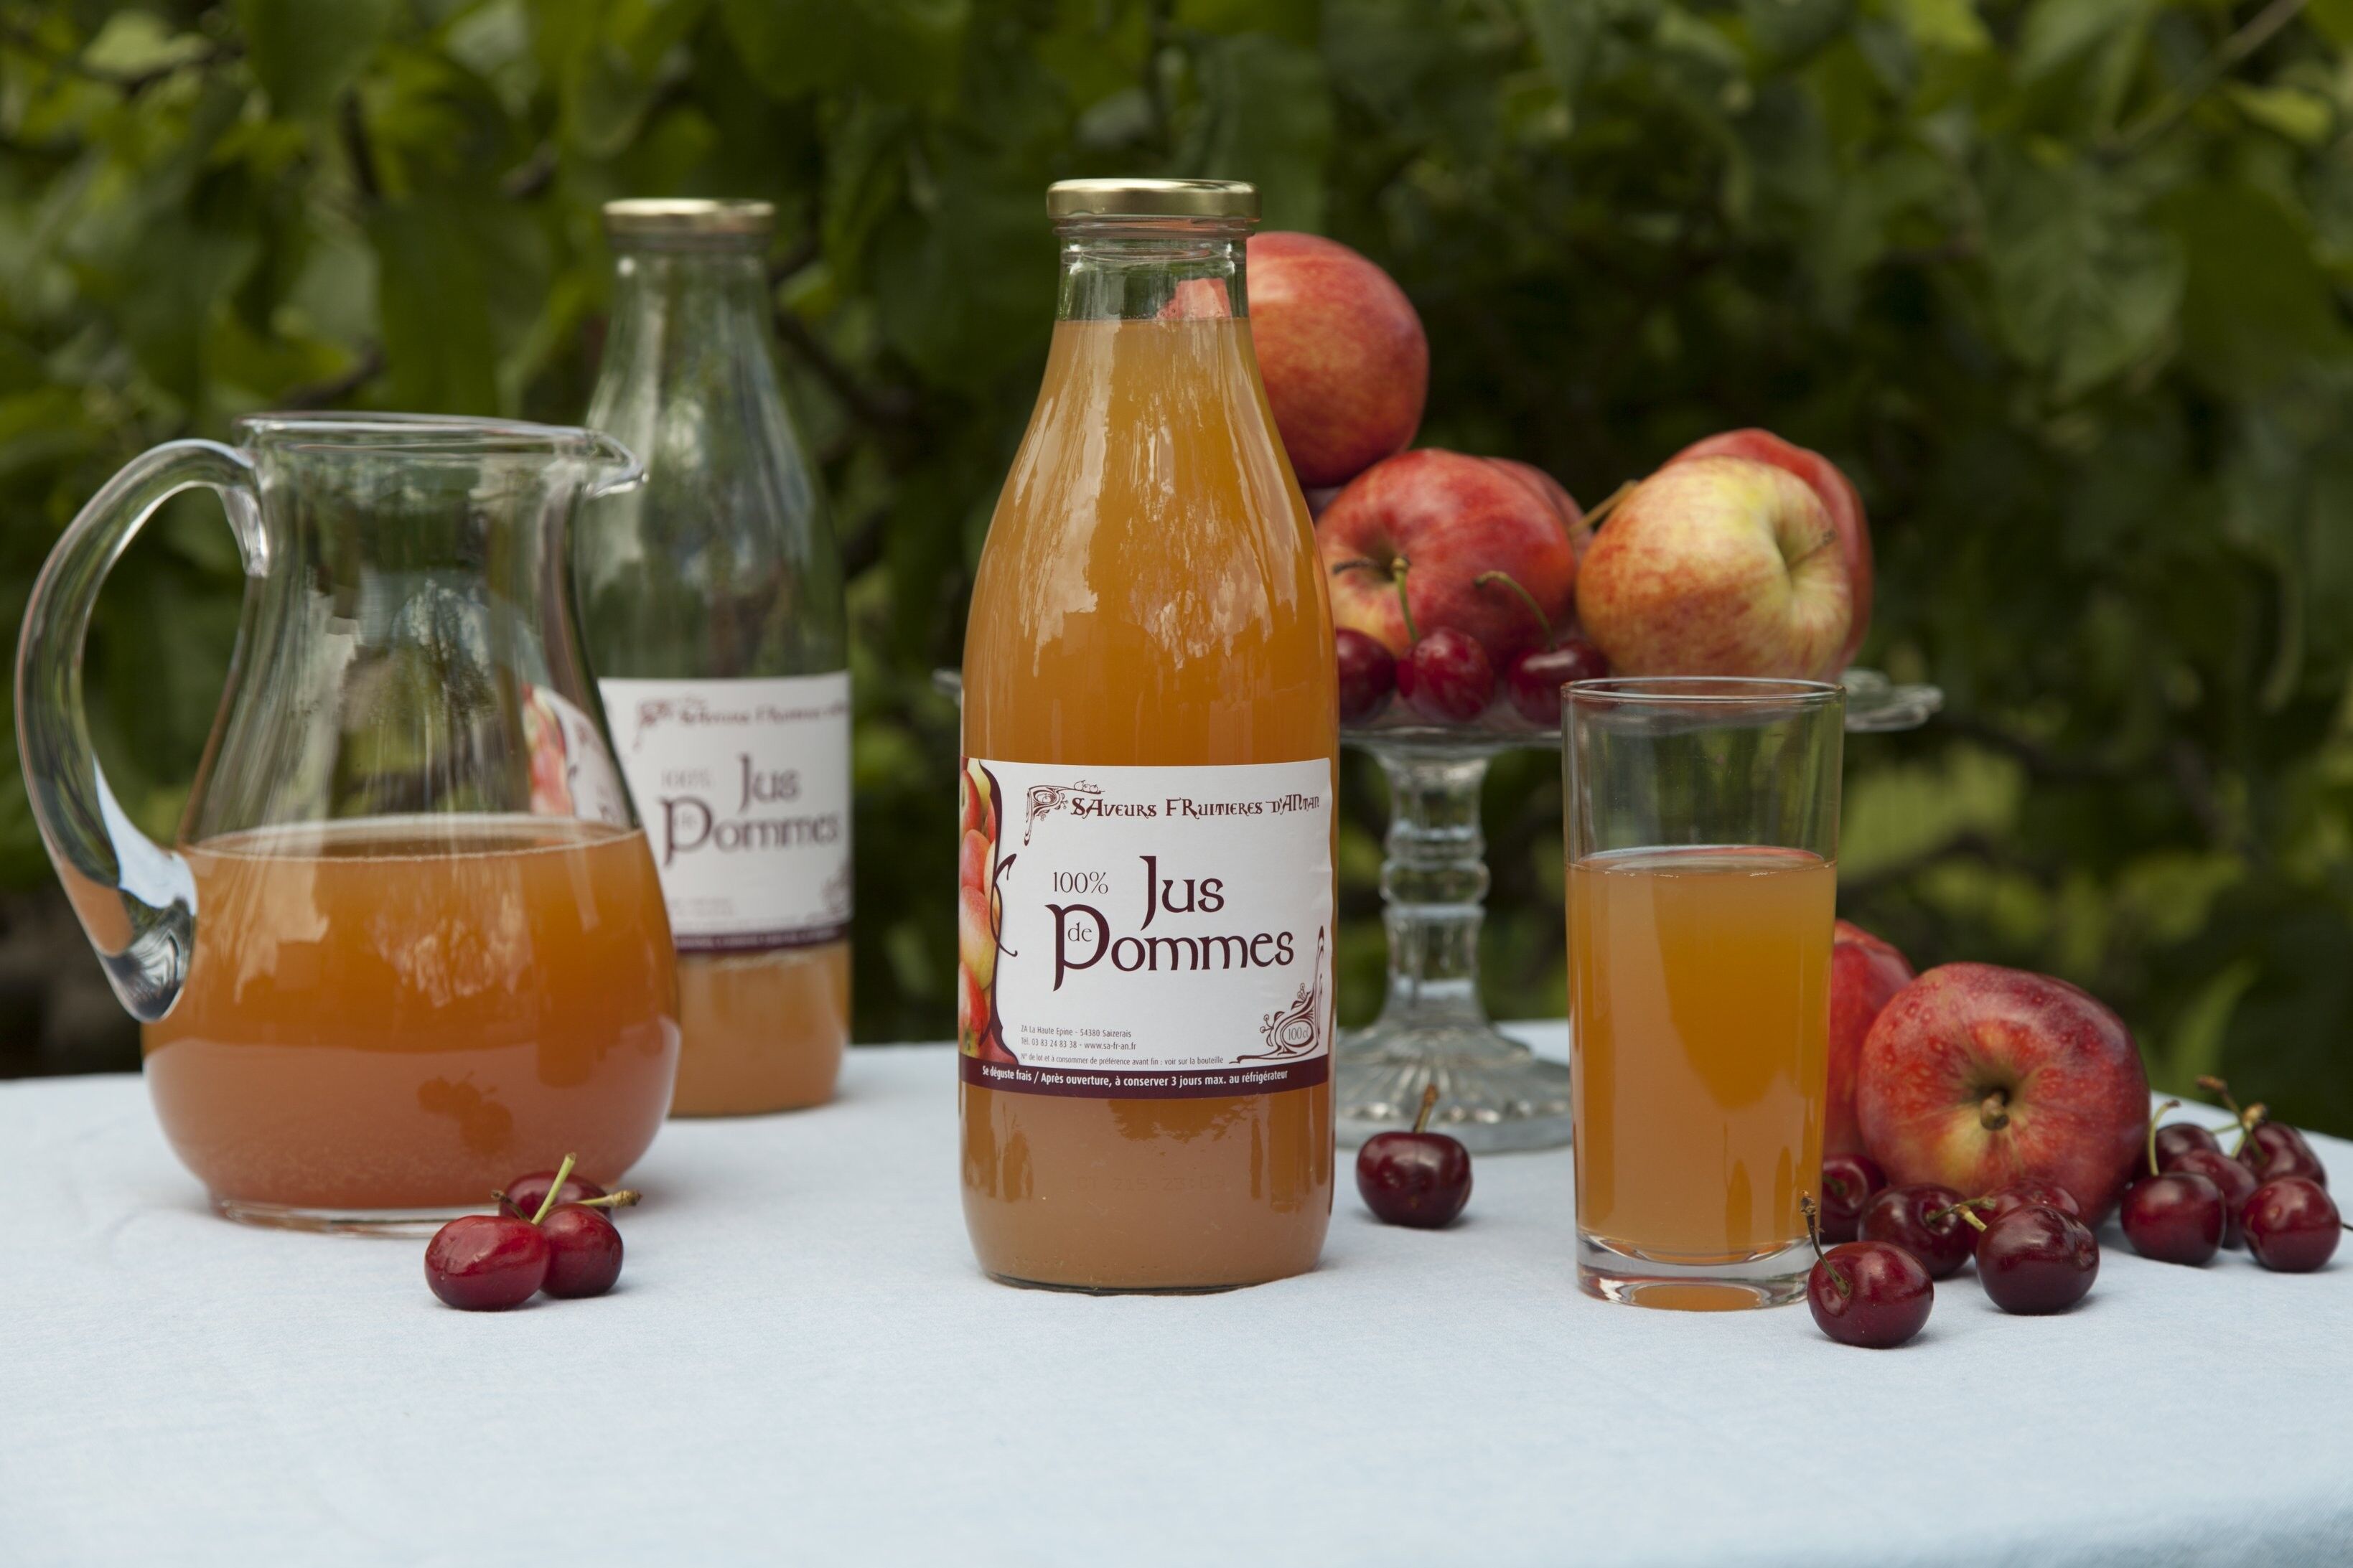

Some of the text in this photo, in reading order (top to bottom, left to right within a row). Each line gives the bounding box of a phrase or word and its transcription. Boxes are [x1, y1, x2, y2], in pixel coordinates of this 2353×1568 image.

[737, 751, 800, 815] Jus
[658, 795, 838, 867] Pommes
[1053, 855, 1225, 931] 100% Jus
[1044, 903, 1294, 992] de Pommes
[1029, 1025, 1035, 1034] La
[1056, 1028, 1073, 1037] Epine
[1102, 1029, 1131, 1038] Saizerais
[1059, 1040, 1067, 1048] 83
[1084, 1041, 1136, 1051] www.sa-fr-an.fr
[982, 1066, 1288, 1089] Se déguste frais / Après ouverture, à conserver 3 jours max. au réfrigérateur
[1099, 1057, 1130, 1066] préférence
